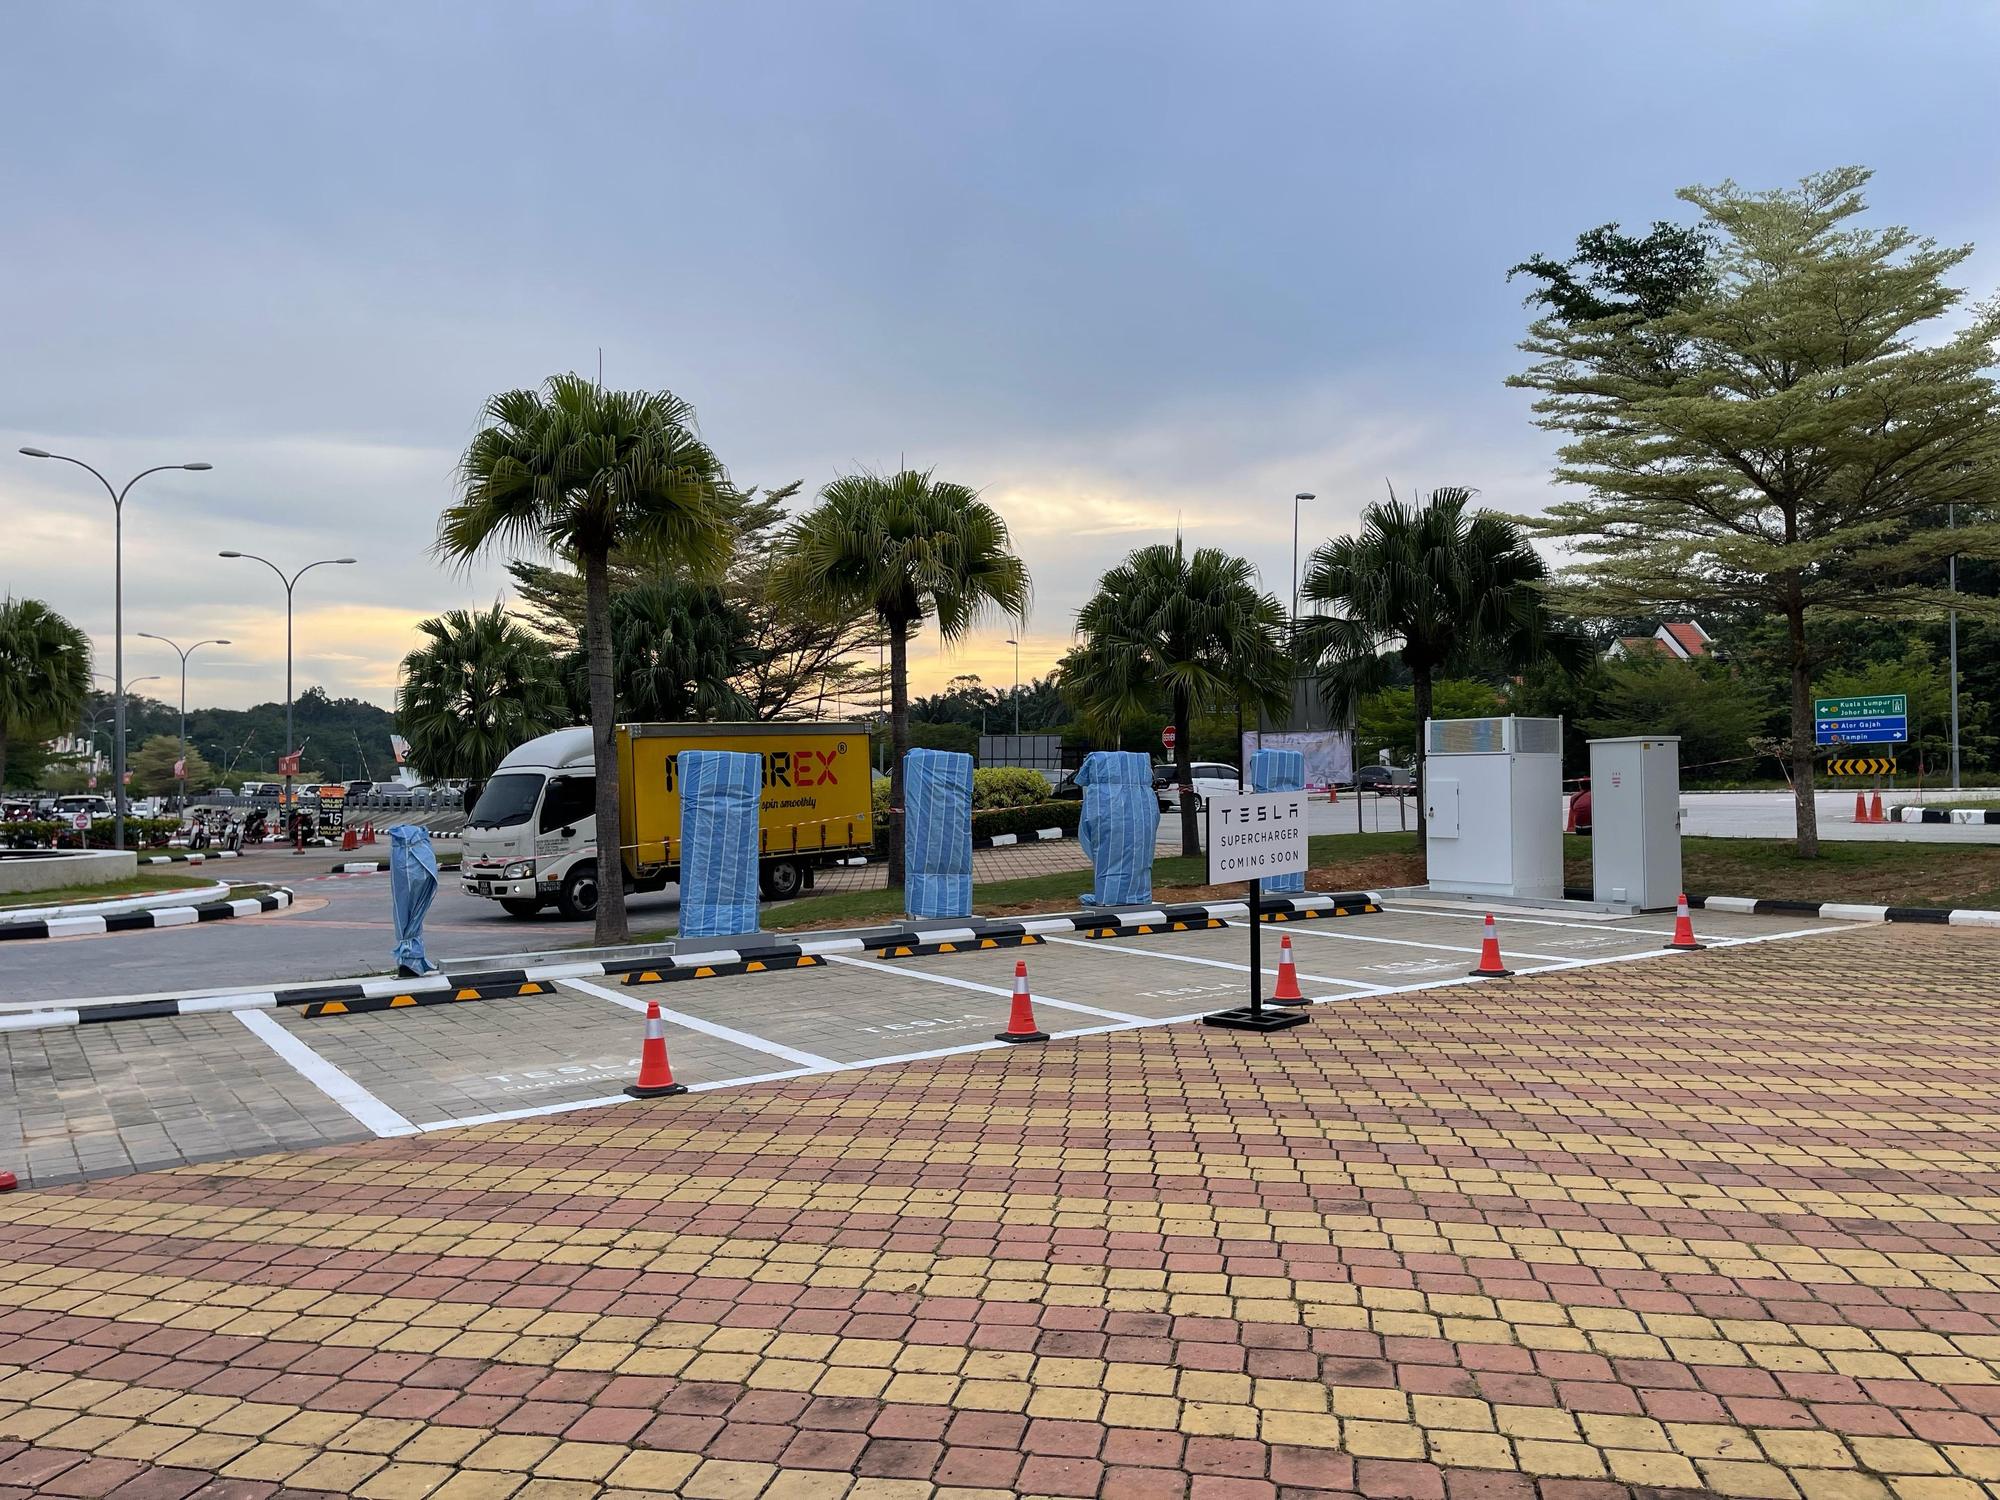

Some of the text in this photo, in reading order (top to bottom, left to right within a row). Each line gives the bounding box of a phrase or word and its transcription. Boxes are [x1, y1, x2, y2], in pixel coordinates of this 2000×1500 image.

[1859, 721, 1881, 729] Gajah
[761, 796, 817, 812] spin smoothly
[328, 813, 342, 825] 15
[1221, 803, 1299, 825] TESLA
[1221, 828, 1299, 847] SUPERCHARGER
[1220, 850, 1299, 871] COMING SOON
[856, 1014, 989, 1034] TESLA
